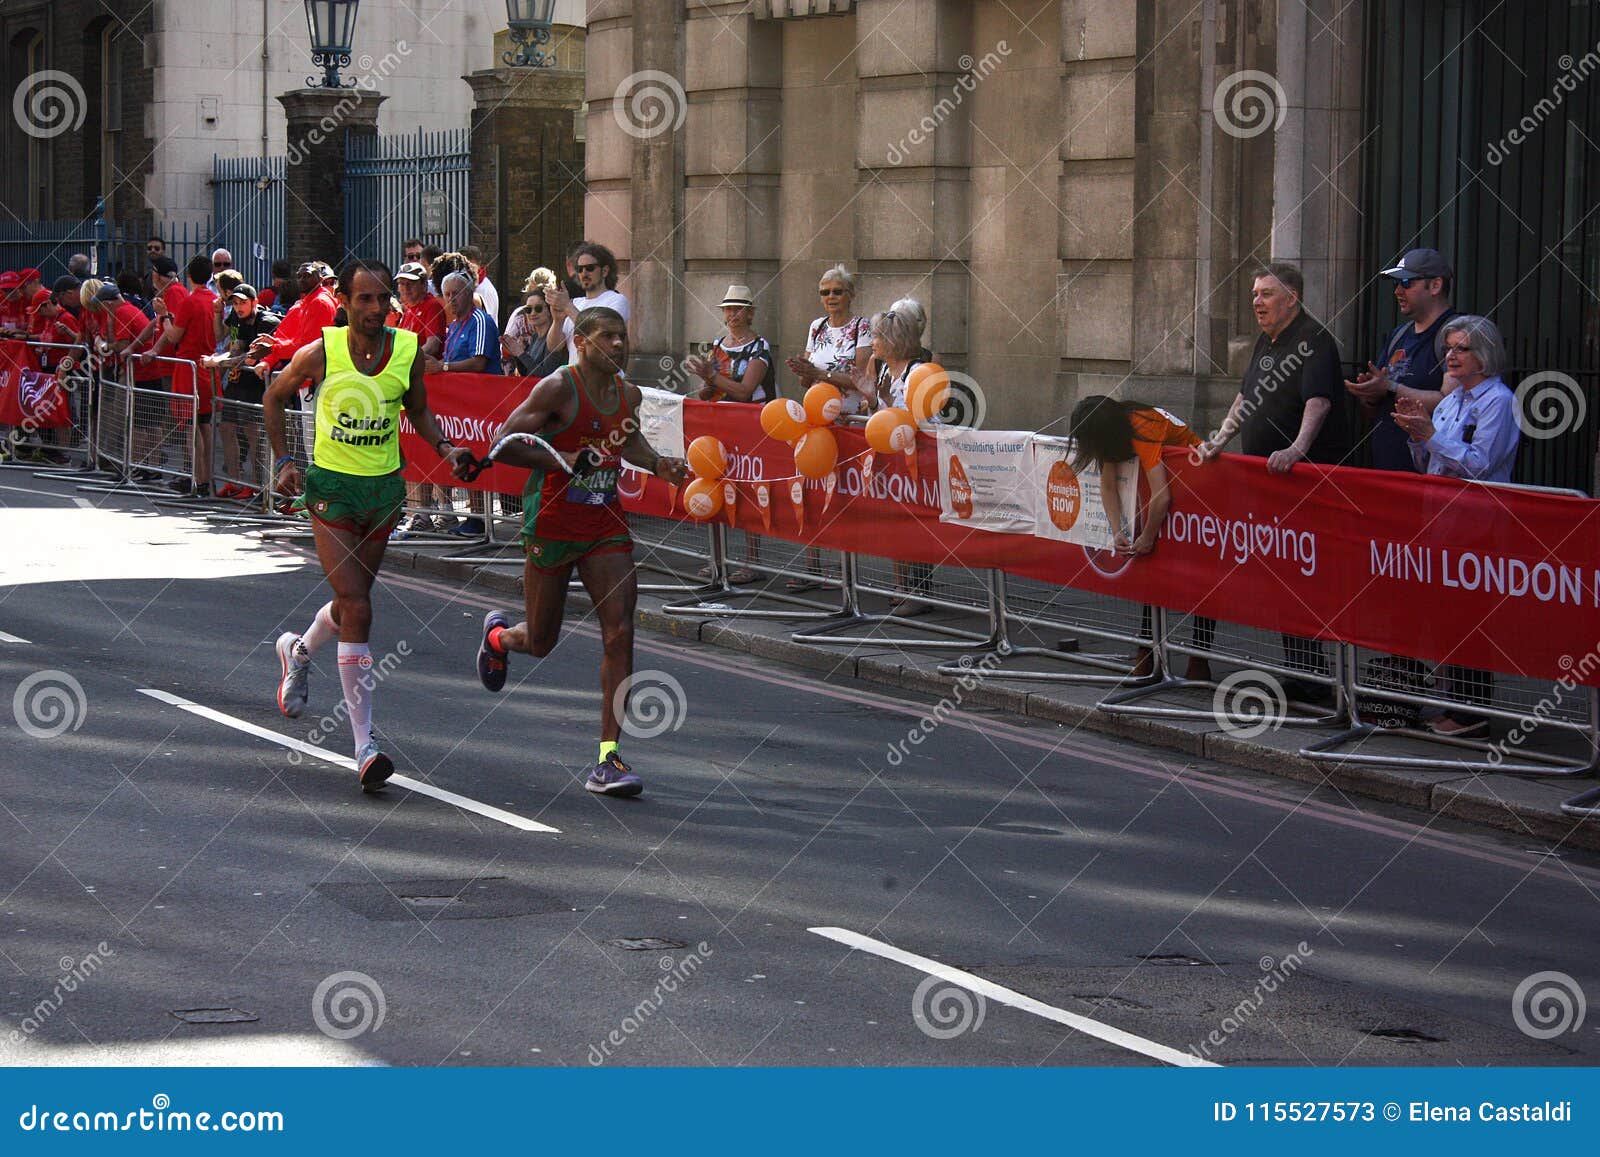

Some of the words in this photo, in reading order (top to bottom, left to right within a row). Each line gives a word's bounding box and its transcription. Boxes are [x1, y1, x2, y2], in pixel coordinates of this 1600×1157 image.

[337, 412, 391, 431] Guide
[435, 414, 485, 442] ONDON
[837, 467, 919, 505] LONDON
[1369, 539, 1432, 584] MINI
[1441, 549, 1581, 606] LONDON
